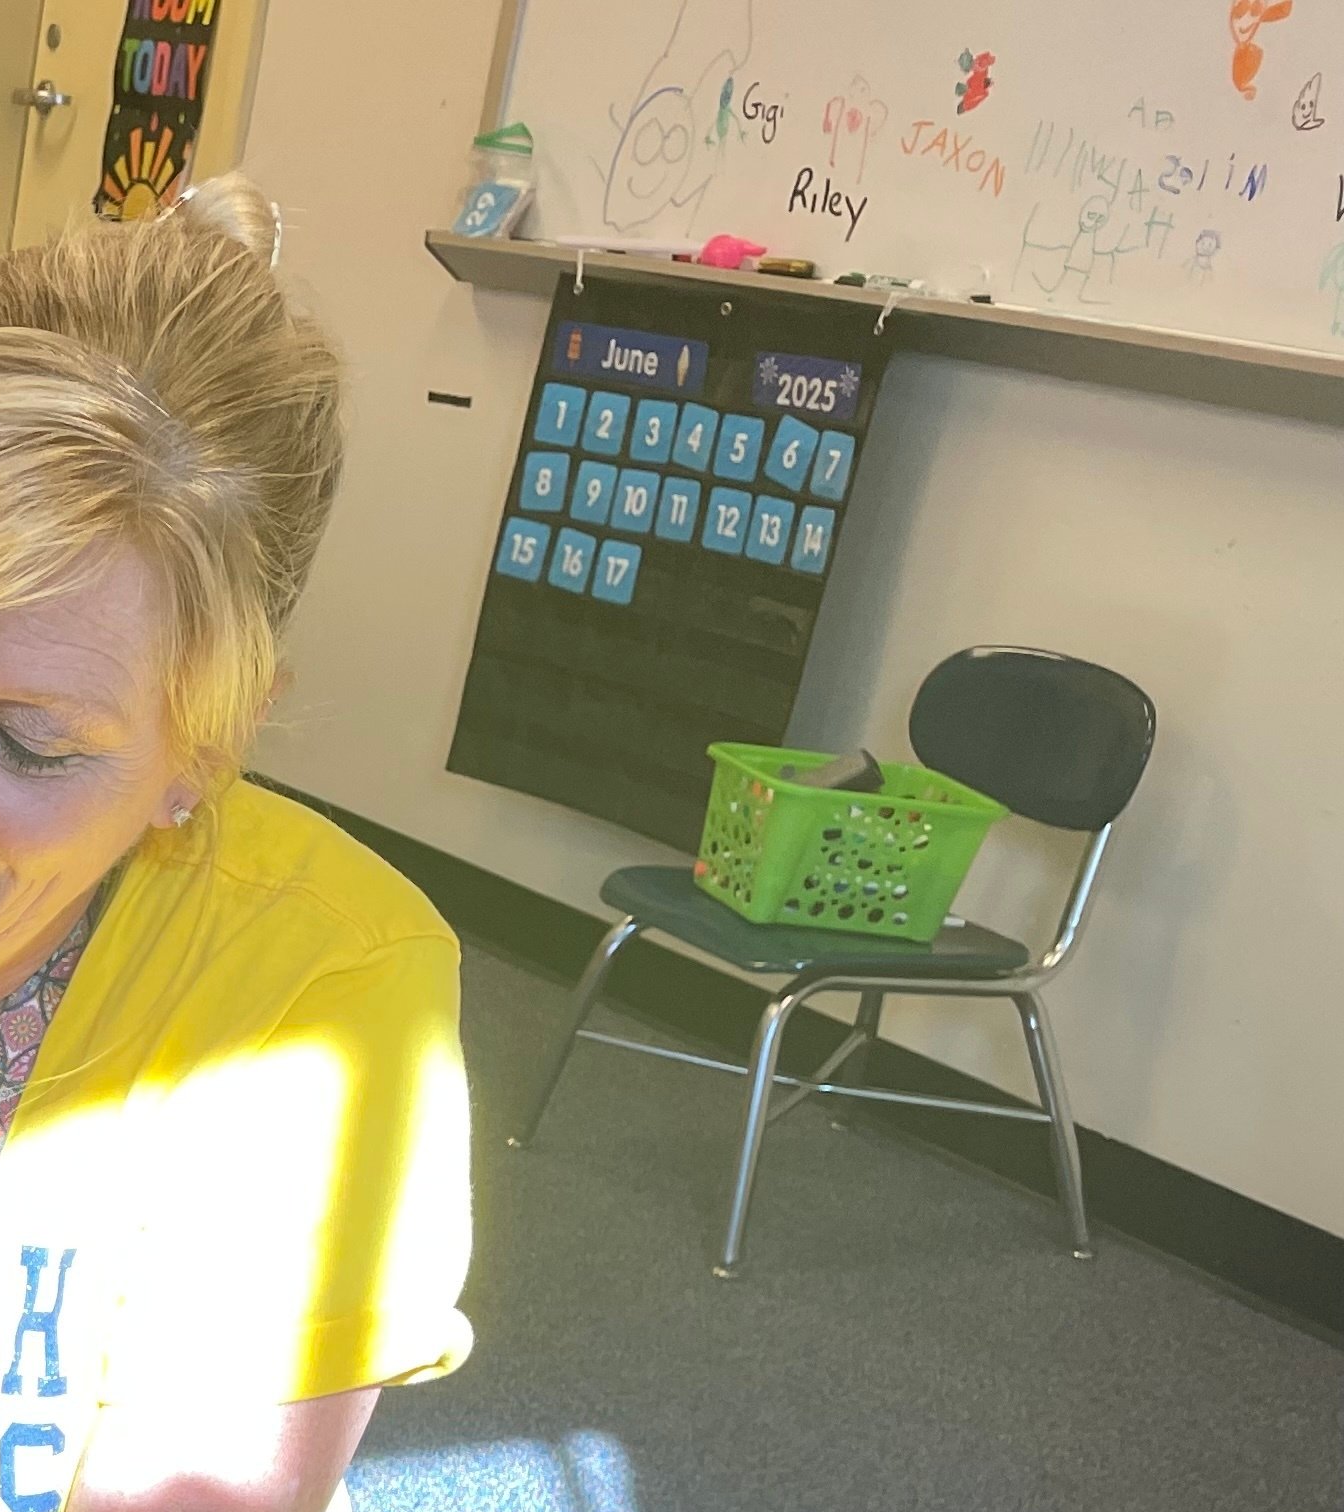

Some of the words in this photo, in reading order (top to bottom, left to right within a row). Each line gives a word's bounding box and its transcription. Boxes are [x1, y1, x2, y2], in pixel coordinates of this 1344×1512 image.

[122, 38, 207, 101] TODAY
[742, 82, 785, 144] Gigi
[900, 120, 1007, 198] JAXON
[465, 191, 496, 227] 29
[788, 167, 868, 243] Riley
[600, 338, 659, 376] June
[775, 373, 838, 413] 2025
[556, 400, 568, 430] 1
[595, 409, 613, 439] 2
[644, 416, 661, 447] 3
[687, 422, 703, 454] 4
[729, 432, 749, 464] 5
[782, 439, 800, 469] 6
[825, 449, 842, 481] 7
[535, 467, 553, 498] 8
[586, 475, 602, 508] 9
[623, 486, 647, 517] 10
[670, 493, 688, 525] 11
[717, 504, 740, 538] 12
[758, 513, 782, 547] 13
[803, 524, 823, 557] 14
[511, 533, 537, 565] 15
[563, 543, 583, 577] 16
[606, 556, 629, 589] 17
